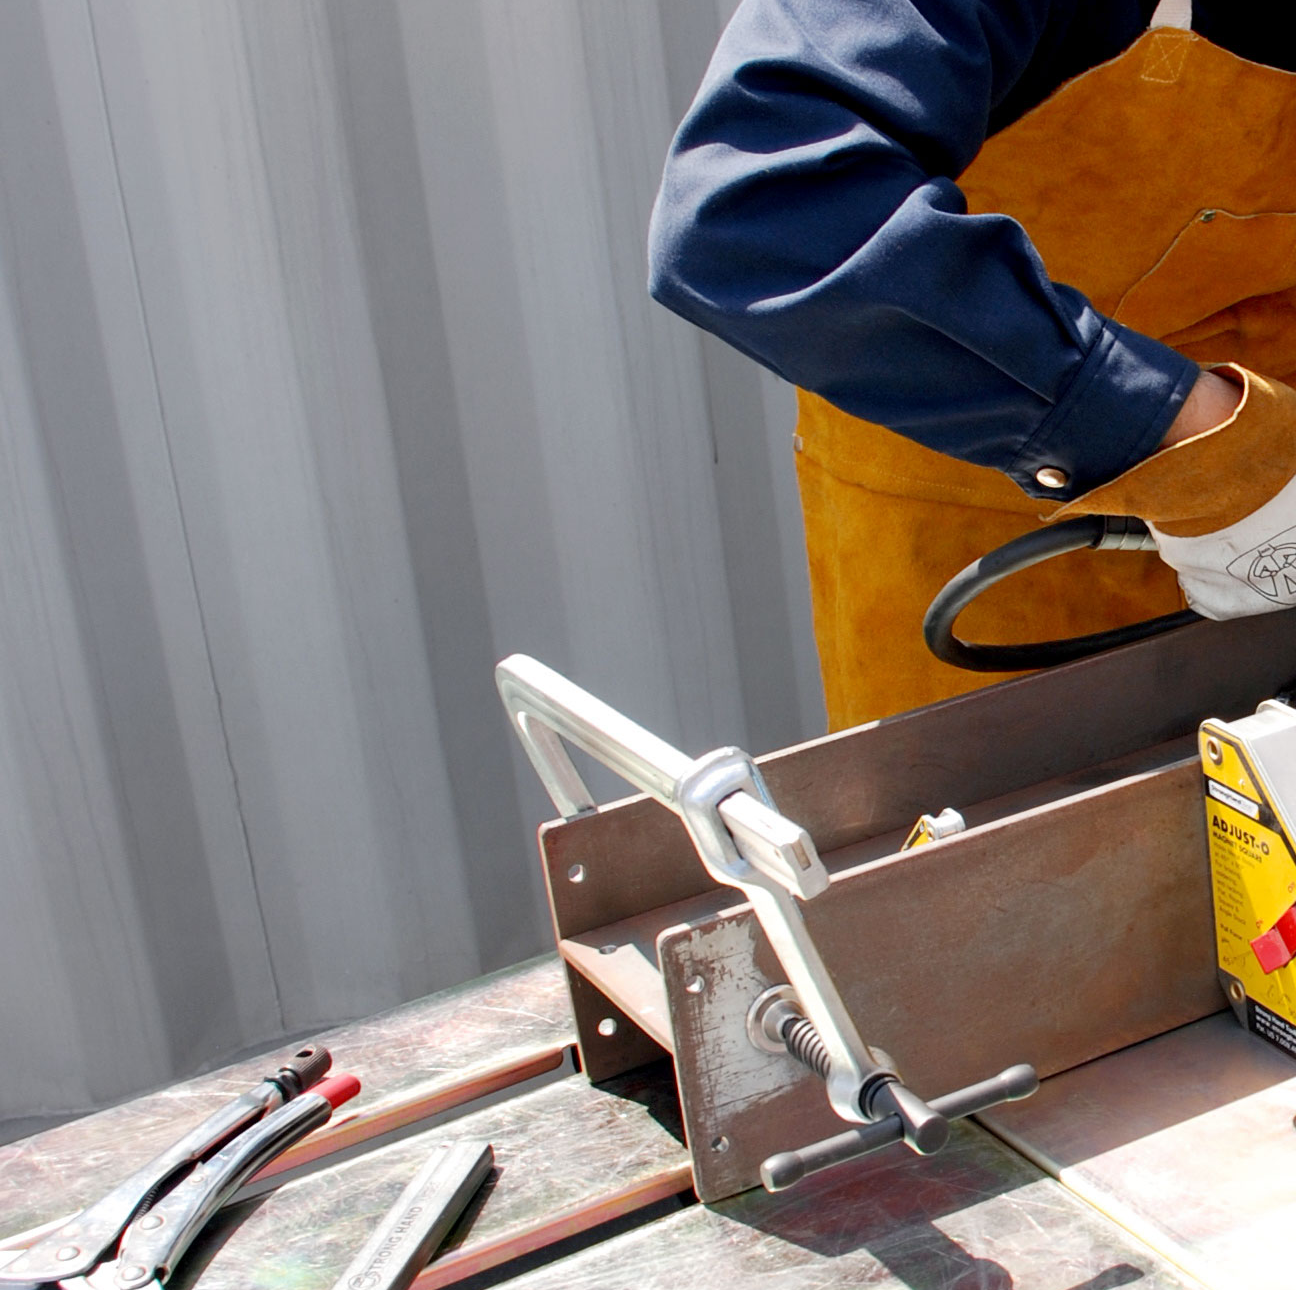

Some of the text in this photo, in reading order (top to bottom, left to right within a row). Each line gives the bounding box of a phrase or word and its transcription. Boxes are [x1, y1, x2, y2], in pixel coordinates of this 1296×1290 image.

[1212, 814, 1270, 856] ADJUST-O
[365, 1206, 423, 1279] STRONG HAND
